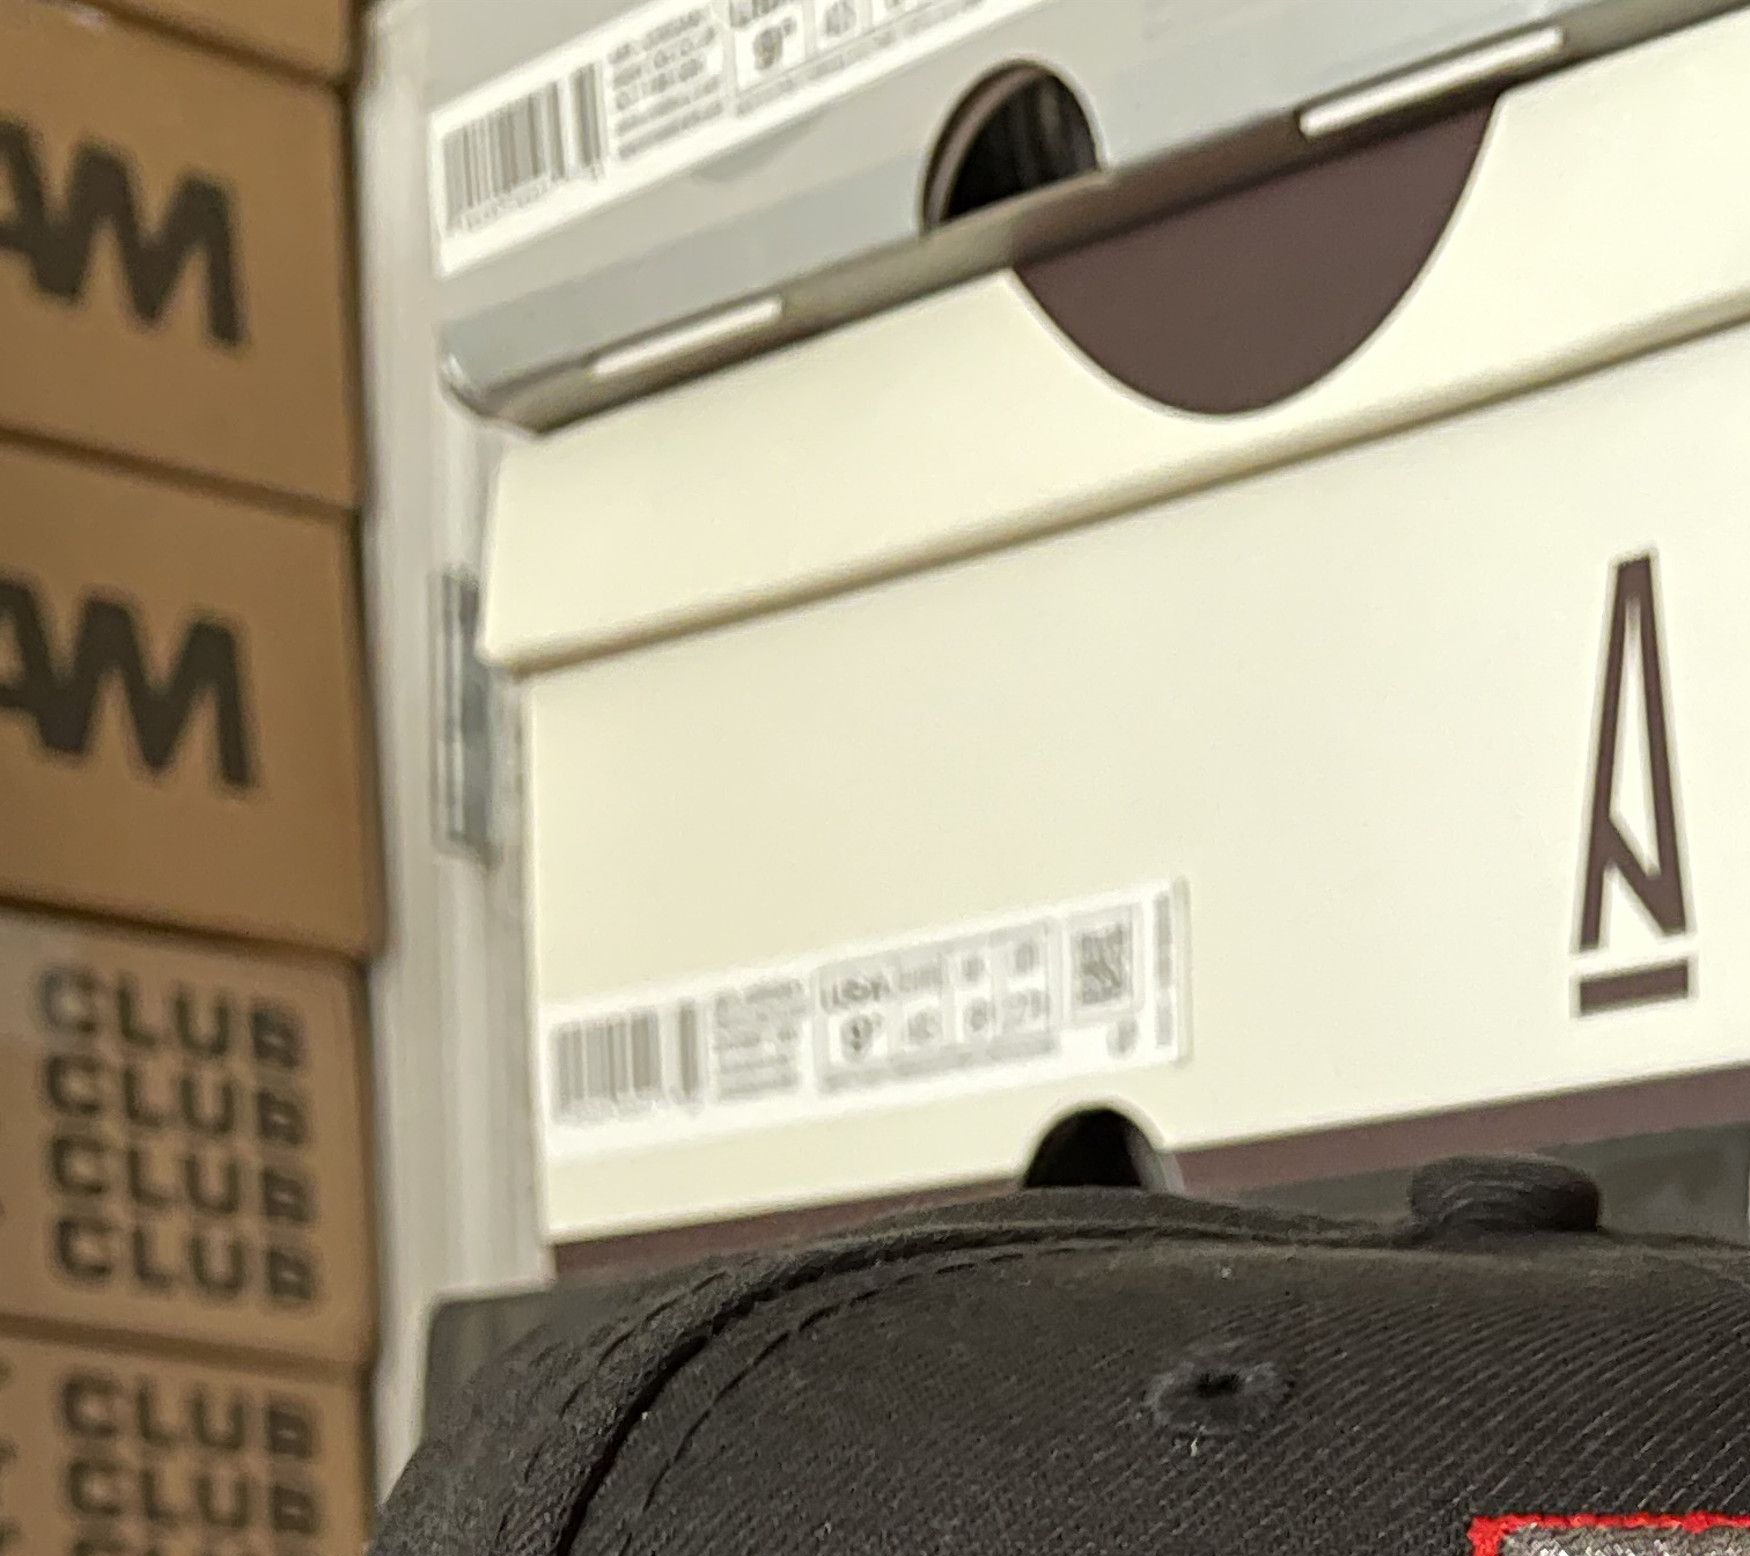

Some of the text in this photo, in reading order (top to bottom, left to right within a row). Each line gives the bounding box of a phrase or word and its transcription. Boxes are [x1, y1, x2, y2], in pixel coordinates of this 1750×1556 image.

[40, 968, 299, 1068] CLUB
[45, 1054, 305, 1146] CLUB
[50, 1136, 310, 1226] CLUB
[55, 1214, 314, 1303] CLUB
[59, 1371, 314, 1459] CLUB
[66, 1457, 318, 1534] CLUB
